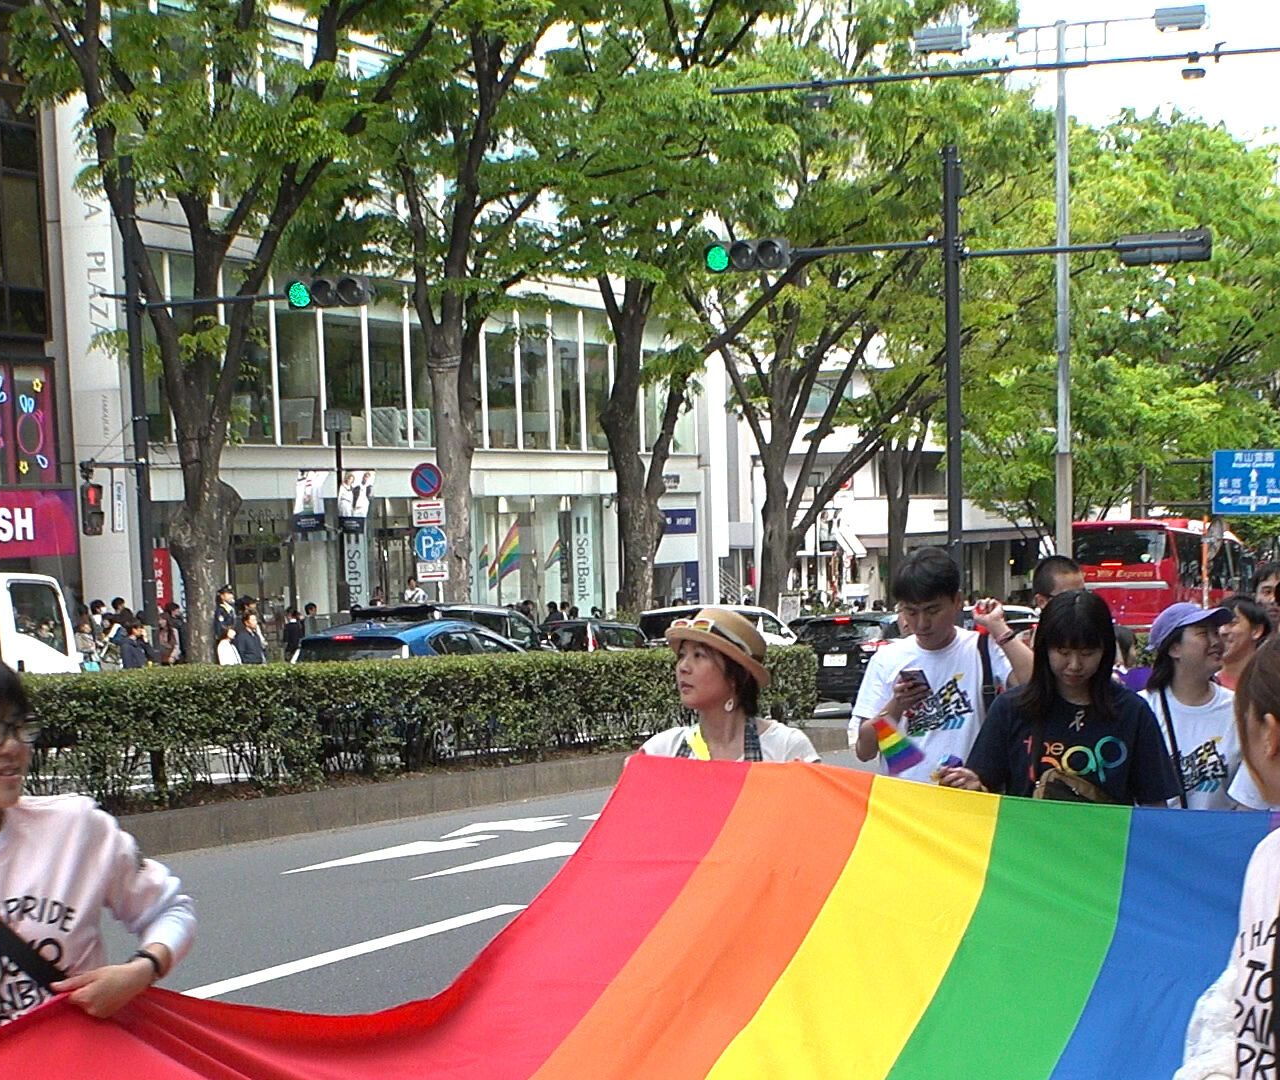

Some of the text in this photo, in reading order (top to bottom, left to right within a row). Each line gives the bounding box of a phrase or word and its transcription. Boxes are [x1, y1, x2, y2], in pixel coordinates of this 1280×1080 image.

[345, 549, 363, 608] SoftBa
[575, 537, 592, 601] SoftBank
[1115, 569, 1154, 579] Express
[6, 895, 76, 932] PRIDE
